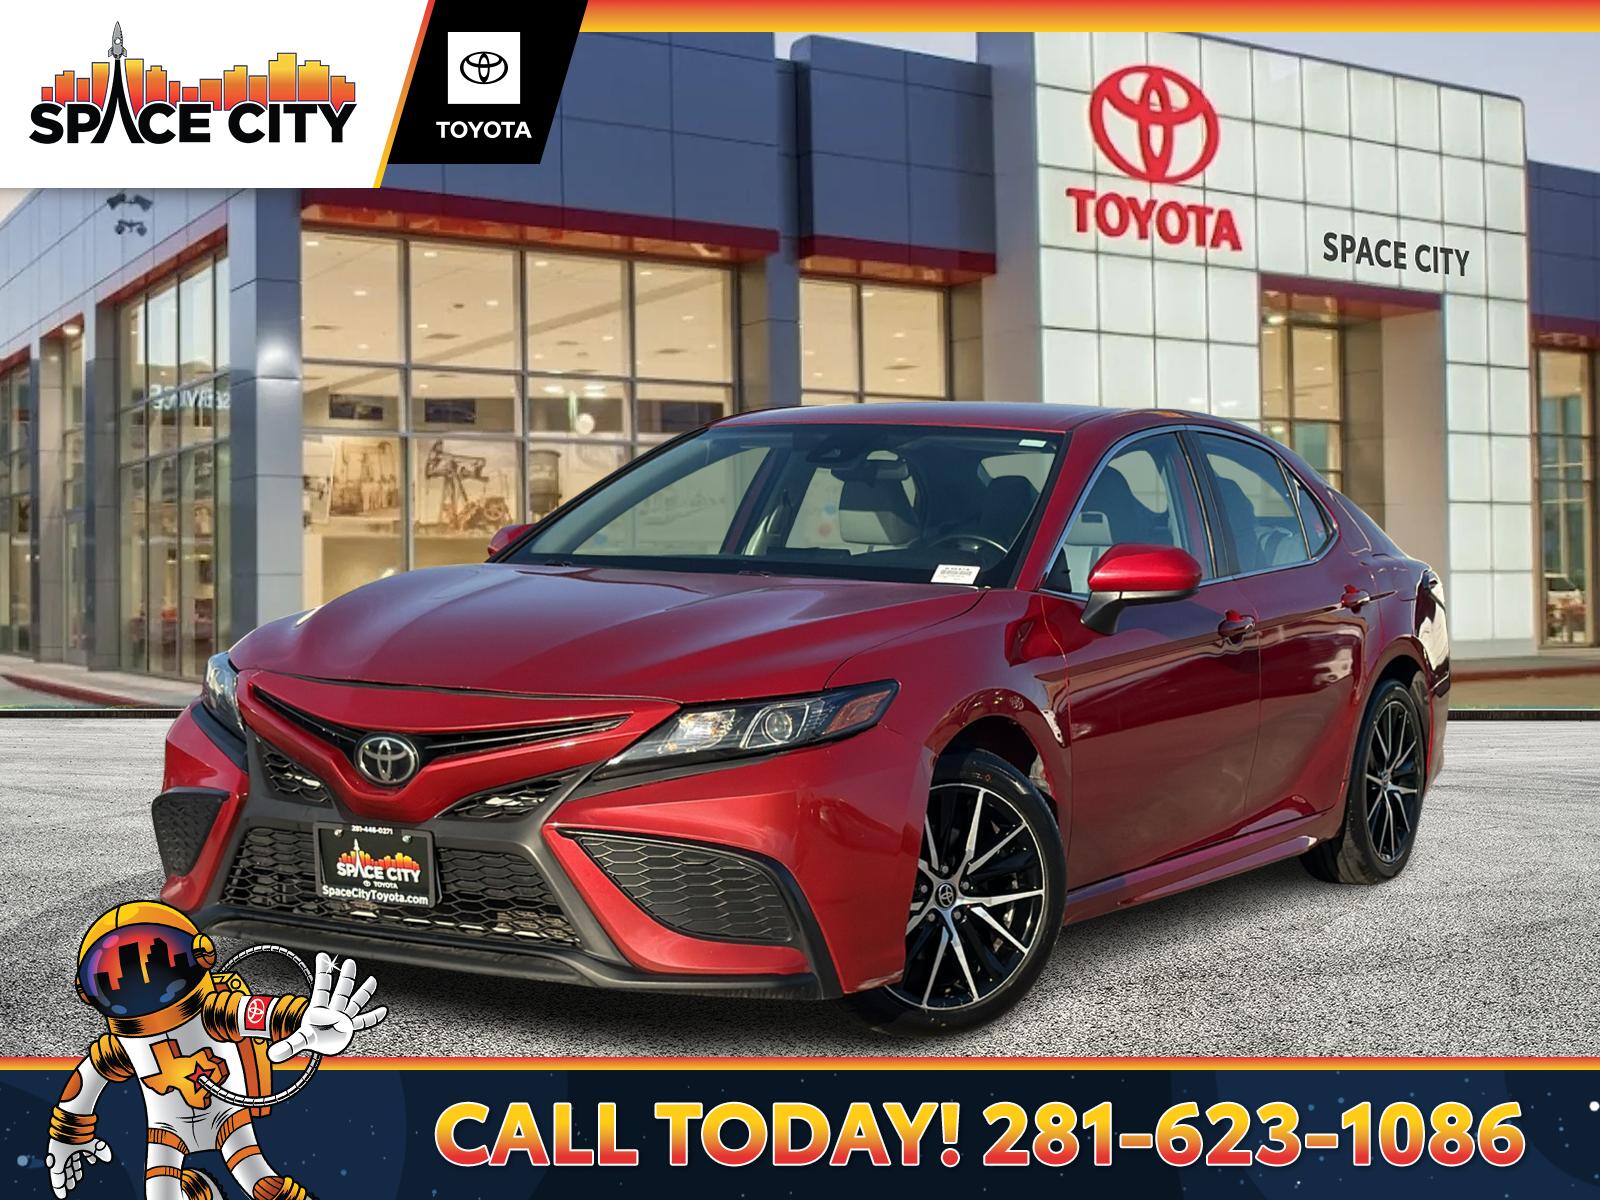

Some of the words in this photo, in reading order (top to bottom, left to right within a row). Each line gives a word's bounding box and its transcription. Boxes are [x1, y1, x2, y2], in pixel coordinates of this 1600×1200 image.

[1066, 187, 1243, 252] TOYOTA
[1322, 231, 1407, 270] SPACE
[1414, 243, 1470, 277] CITY
[336, 850, 384, 880] SPACE
[386, 867, 421, 883] CITY
[322, 885, 429, 905] SpaceCityToyota.com
[373, 880, 398, 890] TOYOTA
